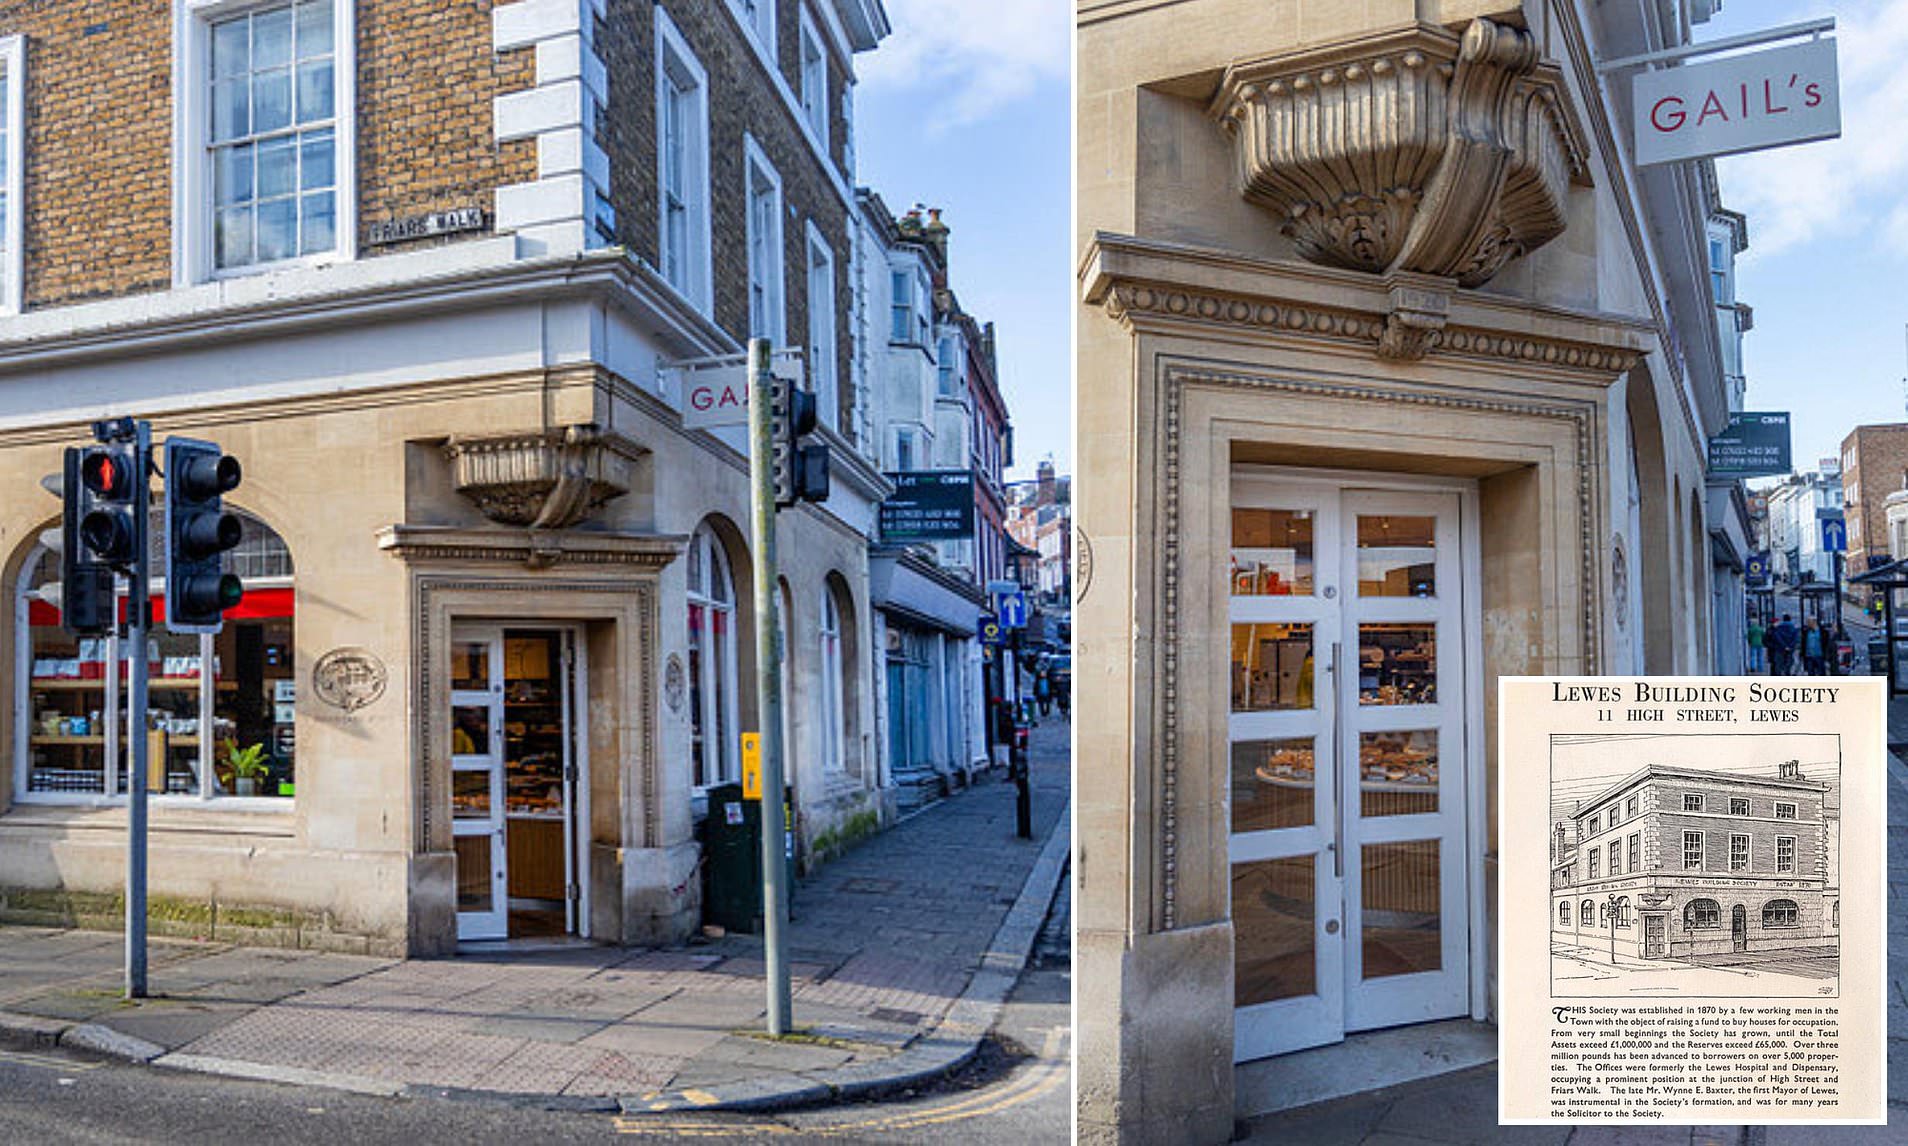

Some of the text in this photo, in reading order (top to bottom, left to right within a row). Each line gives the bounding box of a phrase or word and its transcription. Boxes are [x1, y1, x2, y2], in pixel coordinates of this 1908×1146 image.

[1650, 73, 1822, 132] GAIL's
[1552, 682, 1839, 703] LEWES BUILDING SOCIETY
[1599, 709, 1799, 723] 11 HIGH STREET, LEWES
[1589, 1006, 1619, 1016] Society
[1639, 1006, 1683, 1014] established
[1698, 1006, 1716, 1014] 1870
[1719, 1007, 1728, 1016] by
[1739, 1006, 1754, 1014] few
[1757, 1007, 1791, 1016] working
[1570, 1017, 1593, 1025] Town
[1630, 1018, 1655, 1027] object
[1657, 1017, 1666, 1025] of
[1667, 1018, 1693, 1027] raising
[1733, 1018, 1747, 1027] buy
[1792, 1018, 1838, 1027] occupation.
[1551, 1029, 1838, 1039] From very small beginnings the Society has grown, until the Total
[1610, 1040, 1652, 1049] £1,000,000
[1755, 1040, 1787, 1049] £65,000.
[1793, 1040, 1815, 1048] Over
[1551, 1052, 1579, 1060] million
[1582, 1052, 1611, 1061] pounds
[1629, 1052, 1649, 1060] been
[1651, 1052, 1688, 1060] advanced
[1703, 1052, 1745, 1060] borrowers
[1784, 1052, 1805, 1060] 5,000
[1808, 1054, 1839, 1062] proper-
[1576, 1063, 1592, 1071] The
[1595, 1063, 1623, 1071] Offices
[1649, 1063, 1684, 1073] formerly
[1688, 1063, 1702, 1071] the
[1735, 1063, 1768, 1073] Hospital
[1772, 1063, 1787, 1071] and
[1792, 1063, 1838, 1073] Dispensary,
[1551, 1075, 1591, 1085] occupying
[1605, 1075, 1648, 1085] prominent
[1652, 1075, 1685, 1085] position
[1702, 1075, 1715, 1083] the
[1720, 1075, 1753, 1084] junction
[1757, 1074, 1766, 1082] of
[1770, 1075, 1789, 1084] High
[1794, 1075, 1819, 1083] Street
[1824, 1075, 1838, 1083] and
[1551, 1086, 1574, 1094] Friars
[1576, 1086, 1601, 1094] Walk.
[1610, 1086, 1626, 1094] The
[1646, 1086, 1661, 1094] Mr.
[1663, 1086, 1693, 1096] Wynne
[1696, 1086, 1703, 1094] E.
[1706, 1086, 1735, 1094] Baxter,
[1738, 1086, 1751, 1094] the
[1753, 1086, 1770, 1094] first
[1772, 1086, 1798, 1096] Mayor
[1800, 1086, 1809, 1094] of
[1811, 1086, 1838, 1095] Lewes,
[1569, 1098, 1620, 1106] instrumental
[1635, 1098, 1649, 1106] the
[1653, 1098, 1688, 1107] Society's
[1692, 1098, 1734, 1106] formation,
[1567, 1109, 1602, 1117] Solicitor
[1633, 1109, 1664, 1119] Society.
